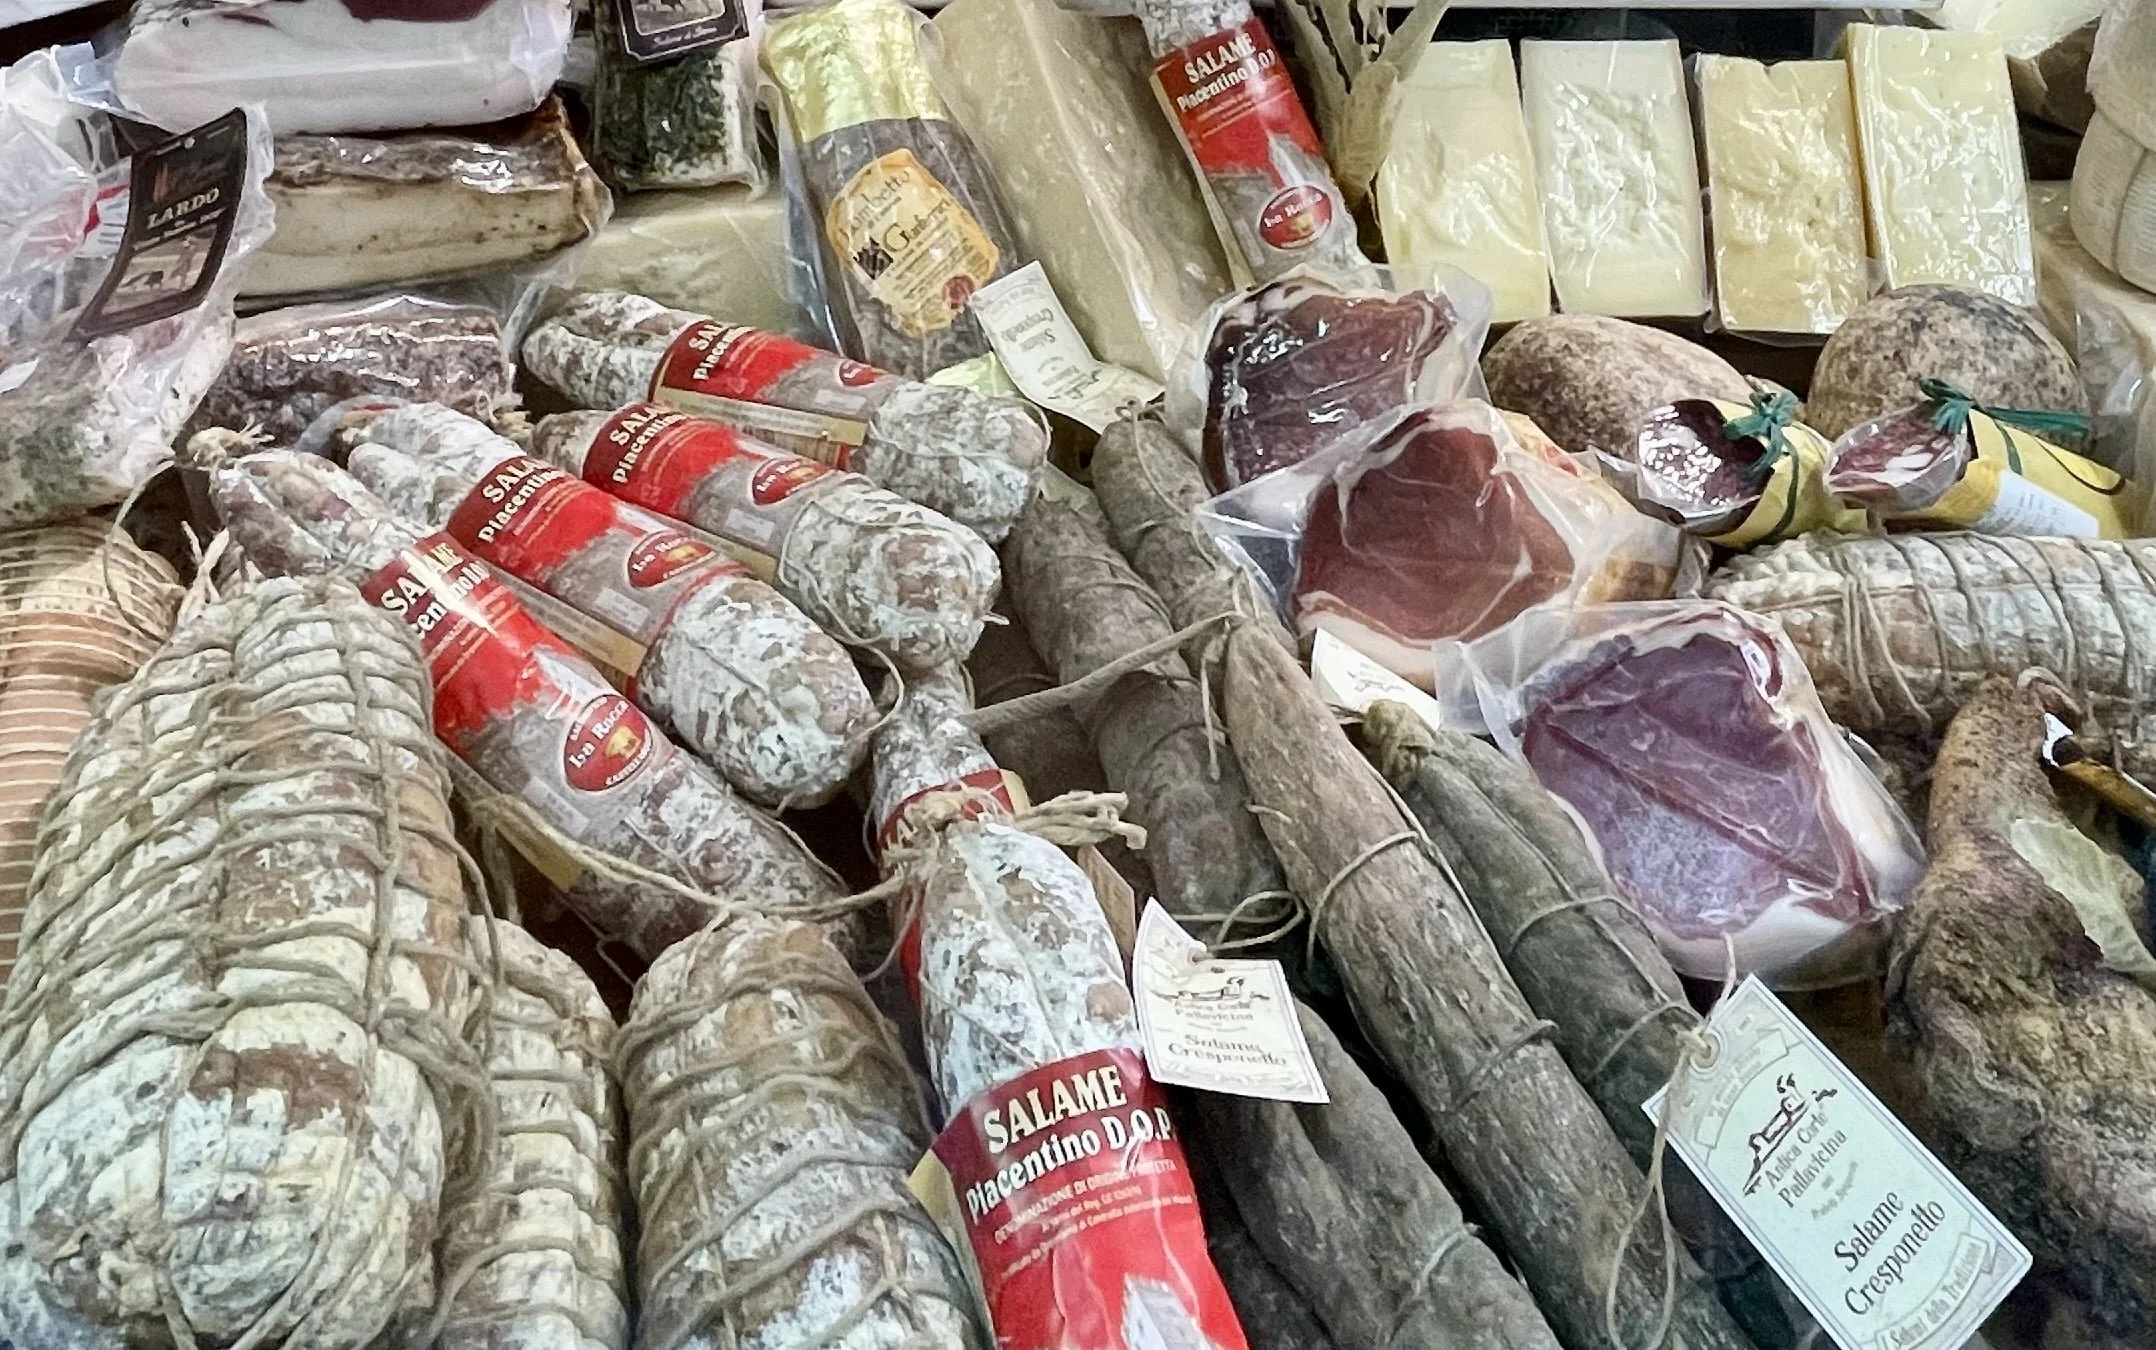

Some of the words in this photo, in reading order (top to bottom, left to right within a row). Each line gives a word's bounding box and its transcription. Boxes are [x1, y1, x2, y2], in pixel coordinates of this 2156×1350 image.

[1177, 67, 1249, 112] Piacentino
[1184, 32, 1257, 84] SALAME
[147, 187, 220, 230] LARDO
[591, 700, 630, 740] Rocca
[982, 1064, 1128, 1155] SALAME
[966, 1128, 1101, 1226] Piacentino
[1764, 1144, 1802, 1189] Antica
[1796, 1111, 1829, 1144] Corte
[1778, 1129, 1848, 1209] Pallavicina
[1833, 1191, 1905, 1273] Salame
[1844, 1200, 1946, 1316] Cresponetto
